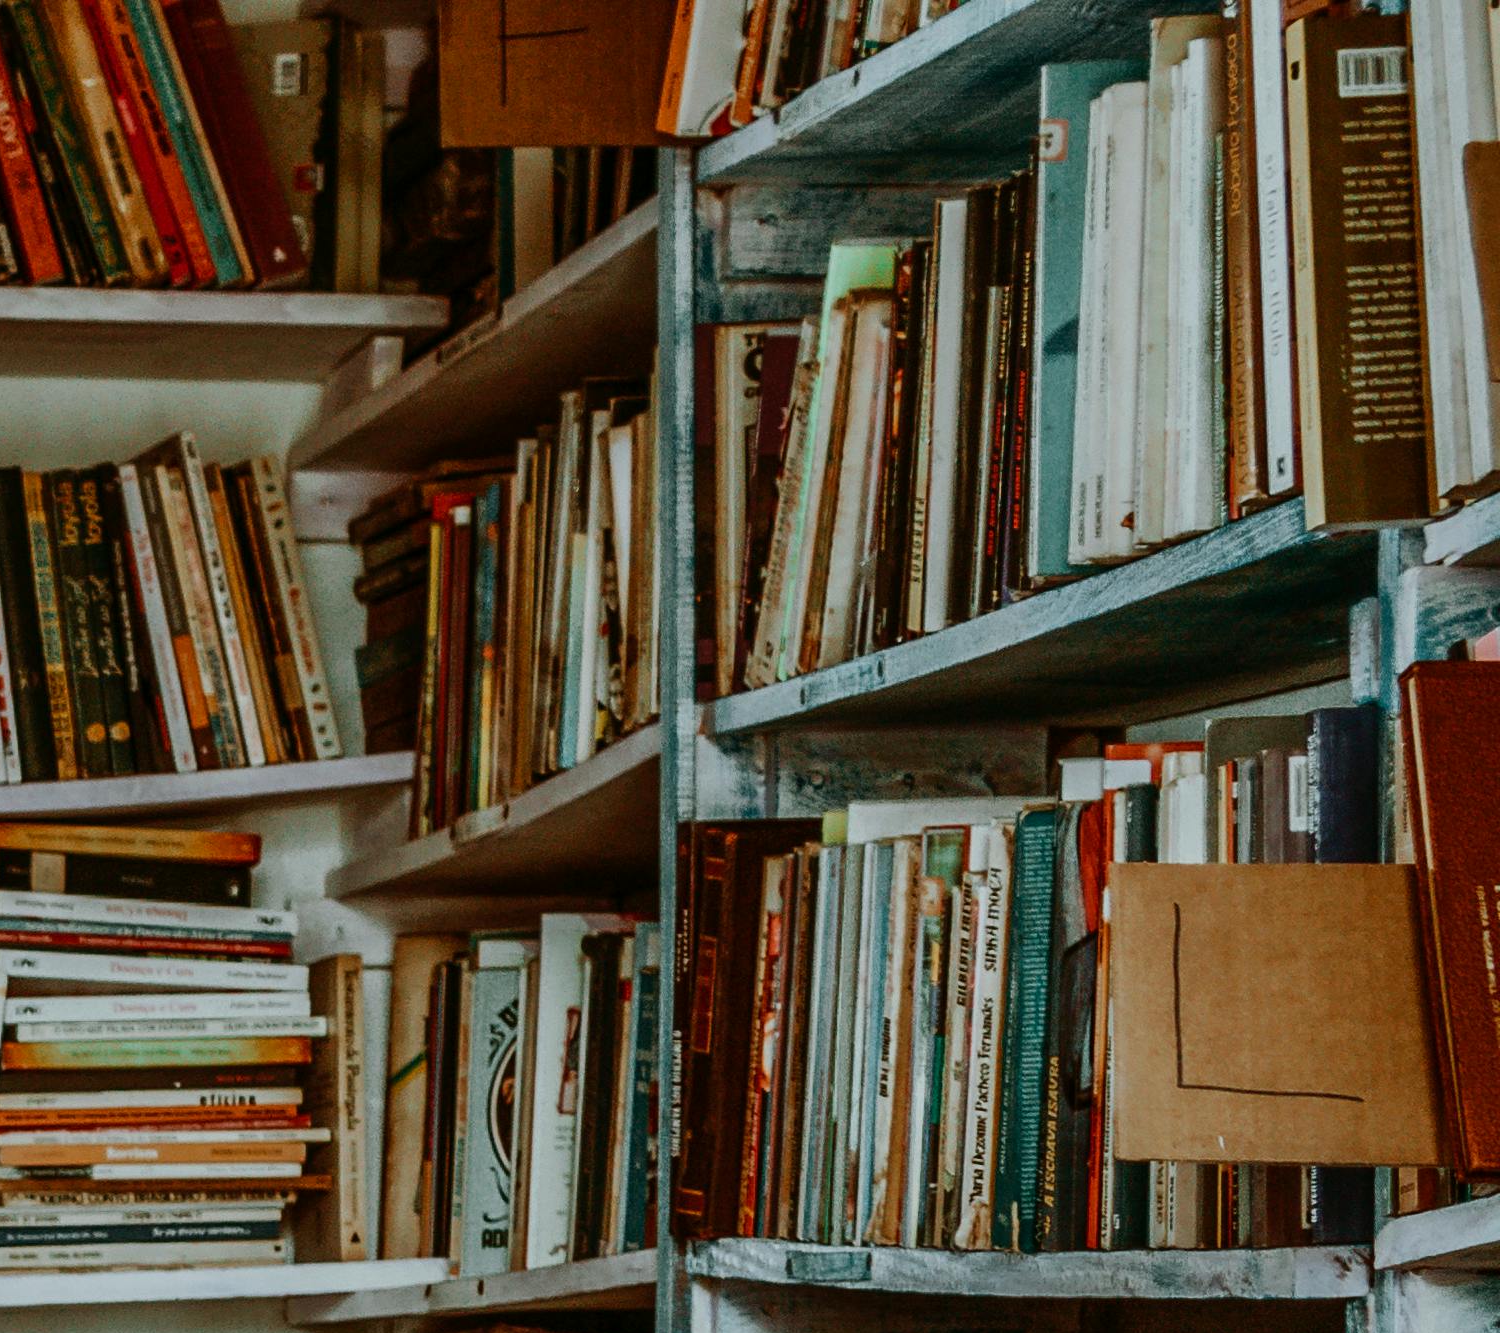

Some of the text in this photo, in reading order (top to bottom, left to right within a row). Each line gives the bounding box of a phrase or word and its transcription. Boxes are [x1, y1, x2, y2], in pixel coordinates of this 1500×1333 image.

[979, 997, 994, 1058] Fernandes
[1173, 901, 1364, 1103] L
[1045, 1055, 1060, 1191] ESCRAVA ISAURA
